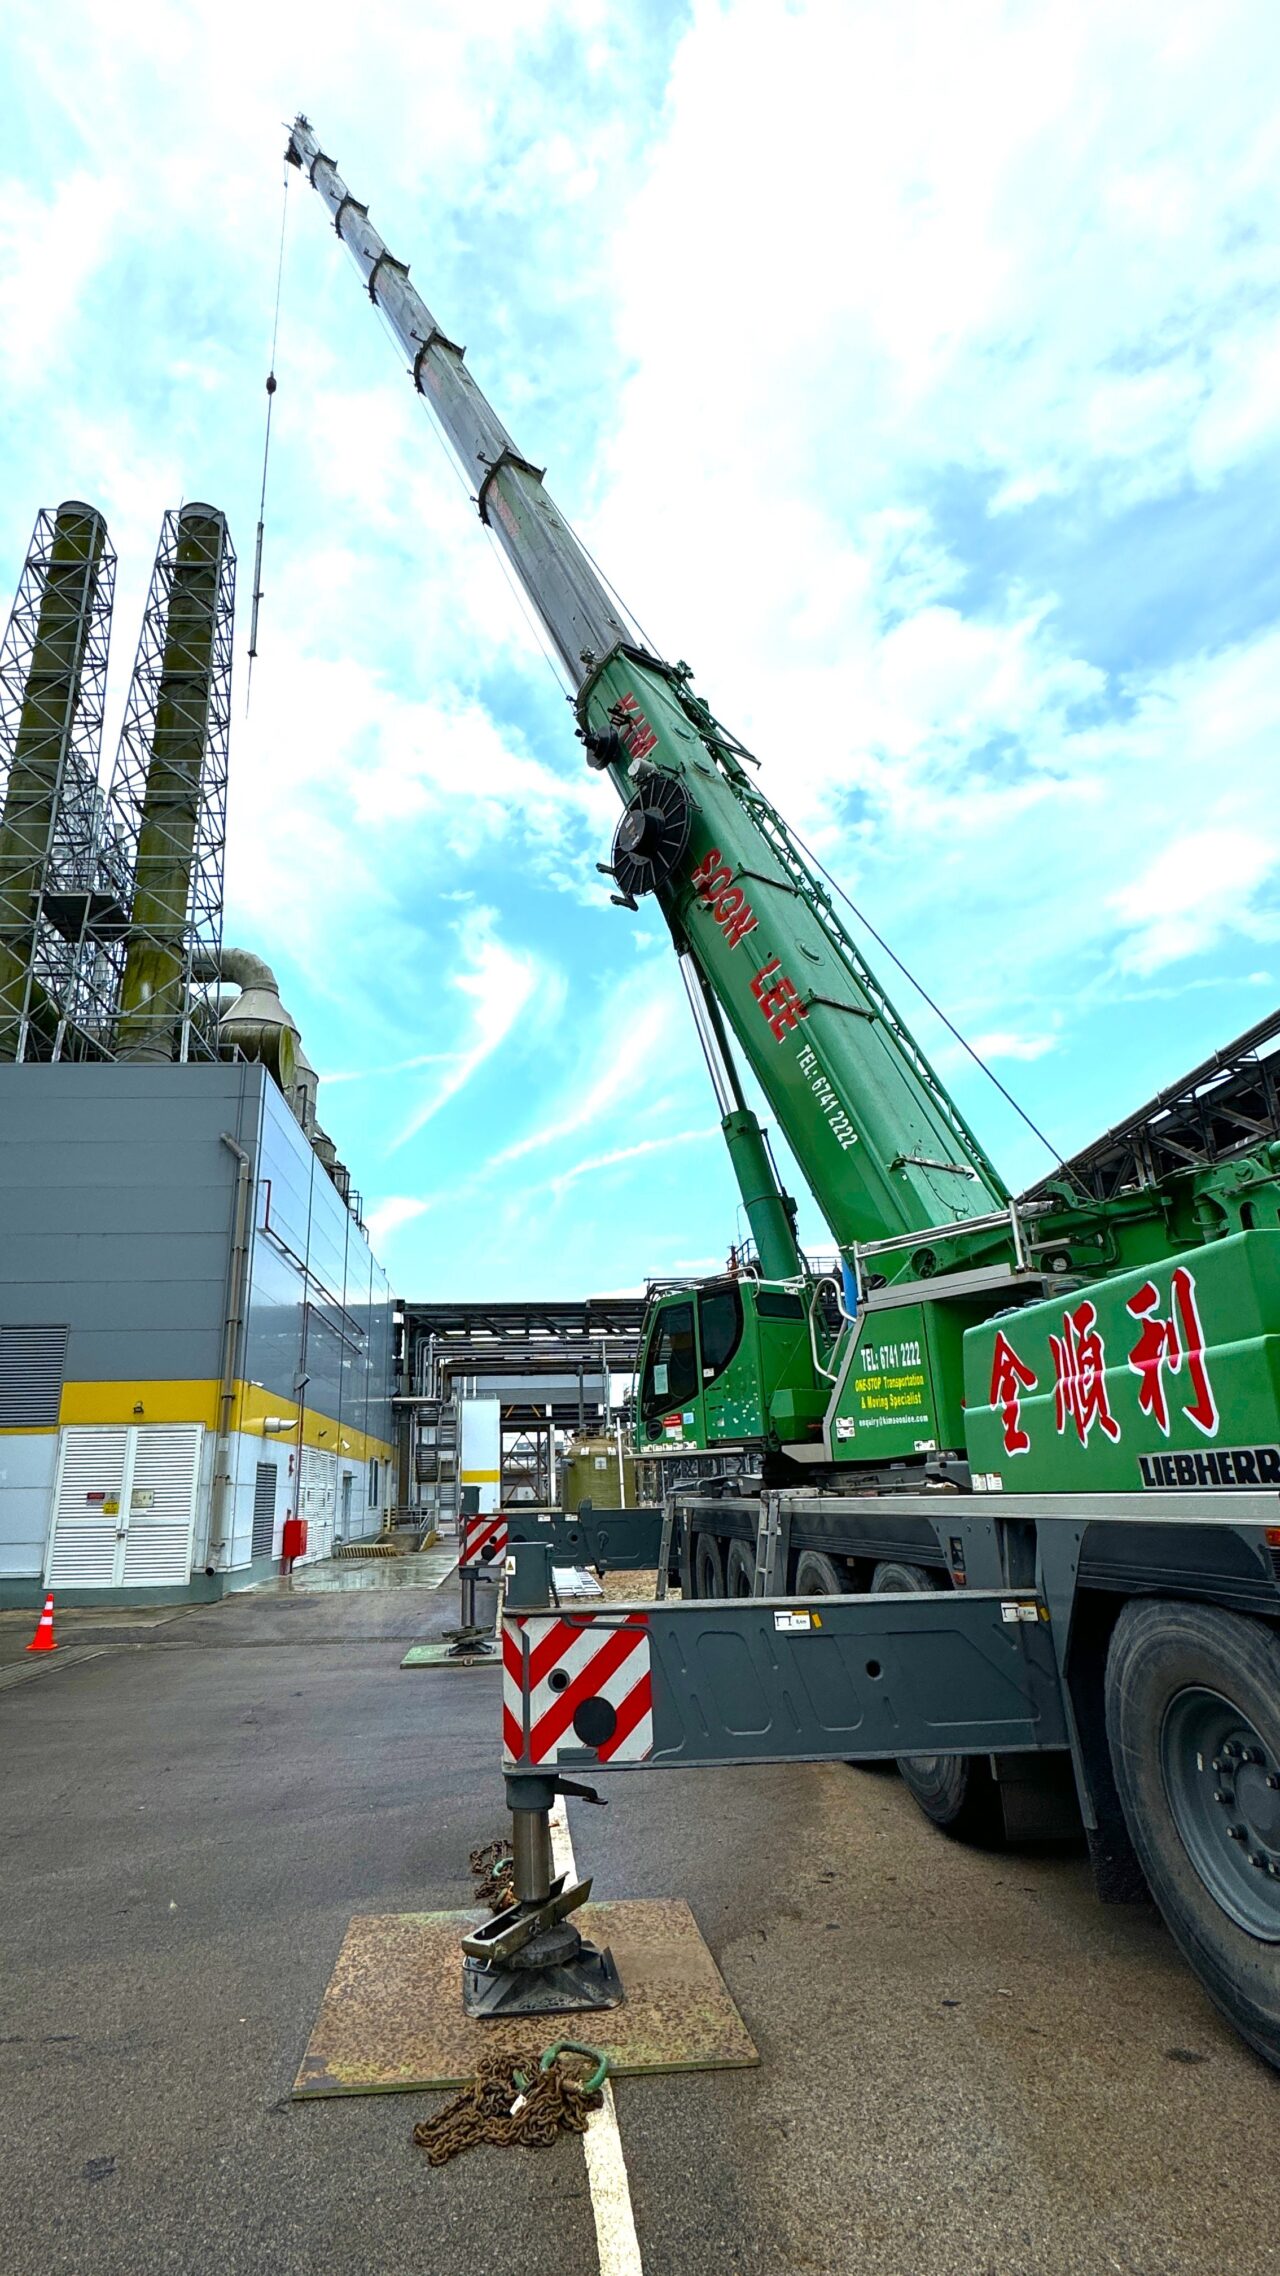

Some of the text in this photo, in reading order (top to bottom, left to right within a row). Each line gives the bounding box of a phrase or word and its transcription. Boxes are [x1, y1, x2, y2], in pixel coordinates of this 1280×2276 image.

[691, 848, 759, 950] SOON
[750, 958, 810, 1044] LEE
[796, 1044, 858, 1151] TEL: 6741 2222
[861, 1341, 921, 1372] TEL: 6741 2222
[855, 1373, 924, 1392] ONE-STOP Transportation
[867, 1395, 888, 1410] Moving
[889, 1392, 921, 1409] Specialist
[1139, 1449, 1280, 1486] LIEBHERR
